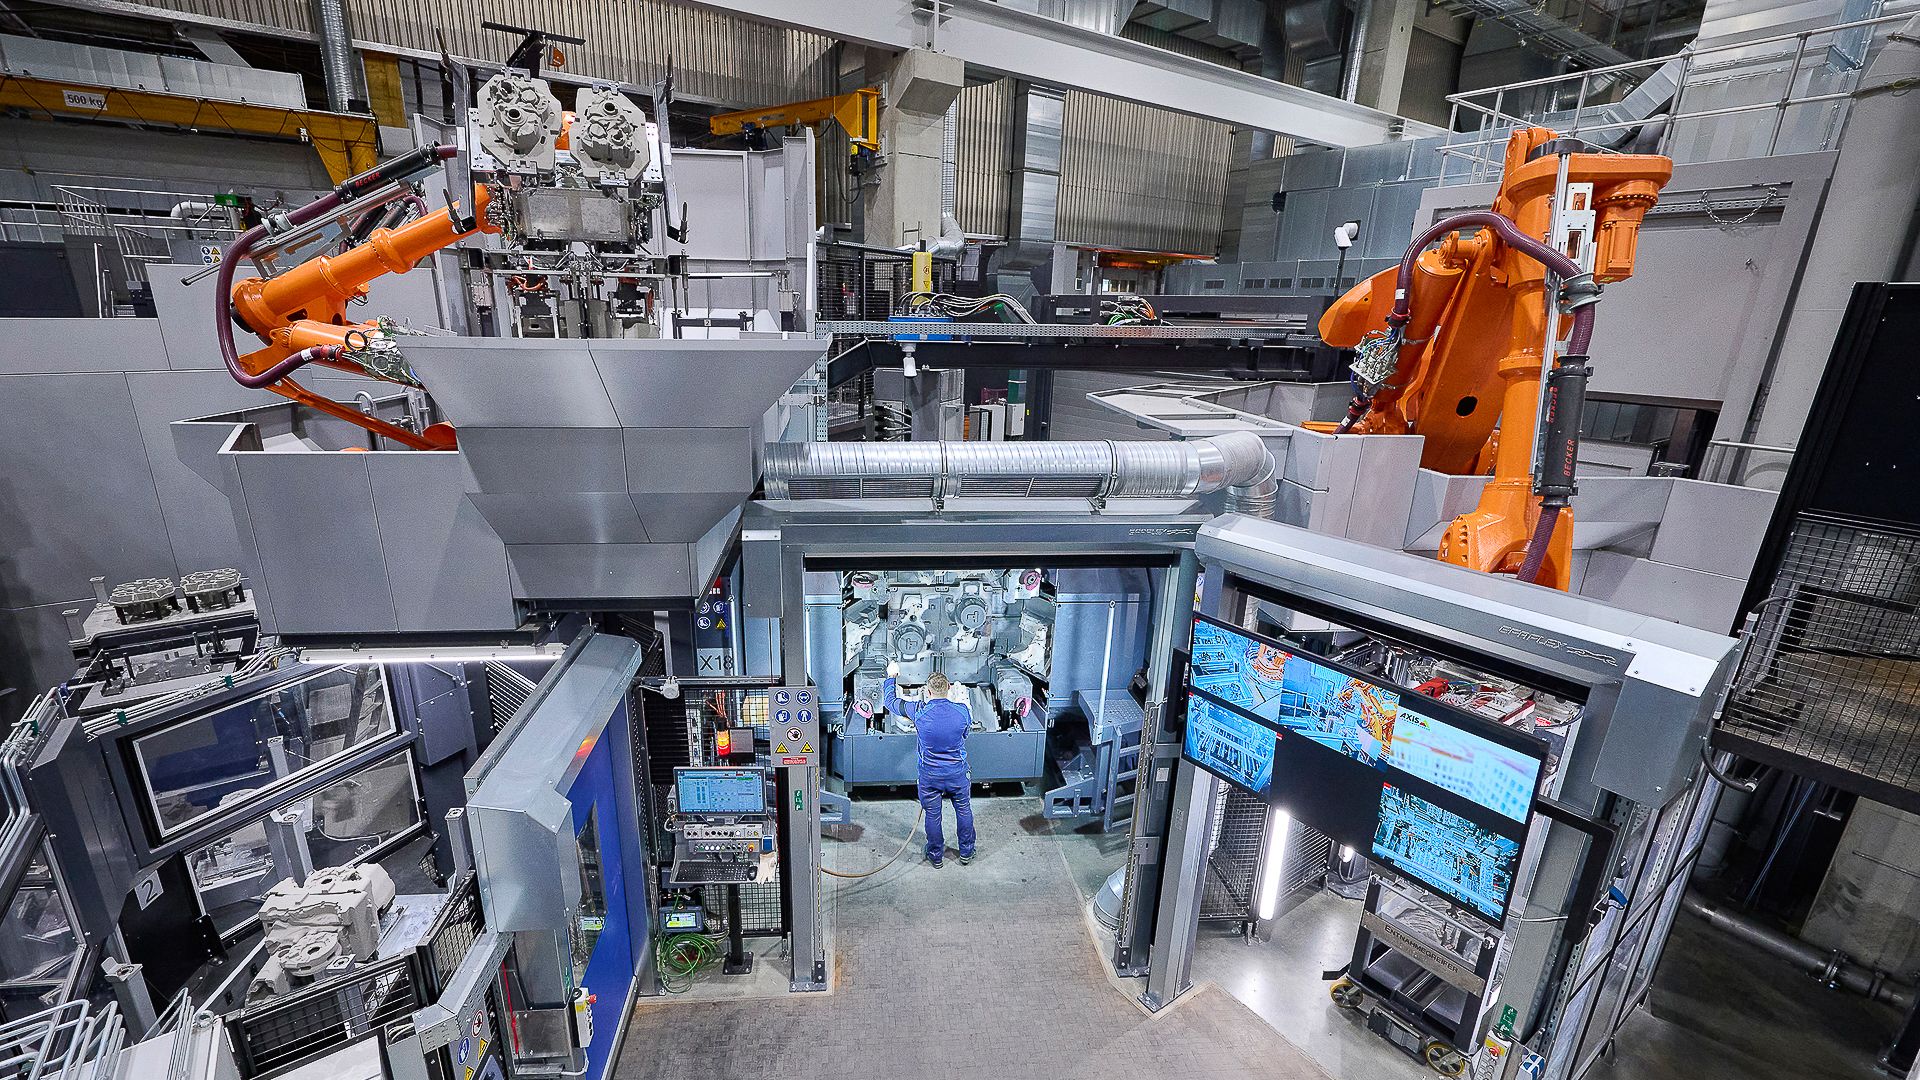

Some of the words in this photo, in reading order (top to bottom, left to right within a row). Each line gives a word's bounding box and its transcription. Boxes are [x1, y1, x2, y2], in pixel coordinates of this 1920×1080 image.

[67, 94, 87, 105] 500
[89, 96, 105, 109] kg
[1563, 439, 1575, 477] BECKER
[700, 655, 733, 671] X18
[1400, 712, 1420, 724] AXIS
[141, 879, 158, 903] 2
[1384, 924, 1459, 974] ENTNAHMEGREIFER
